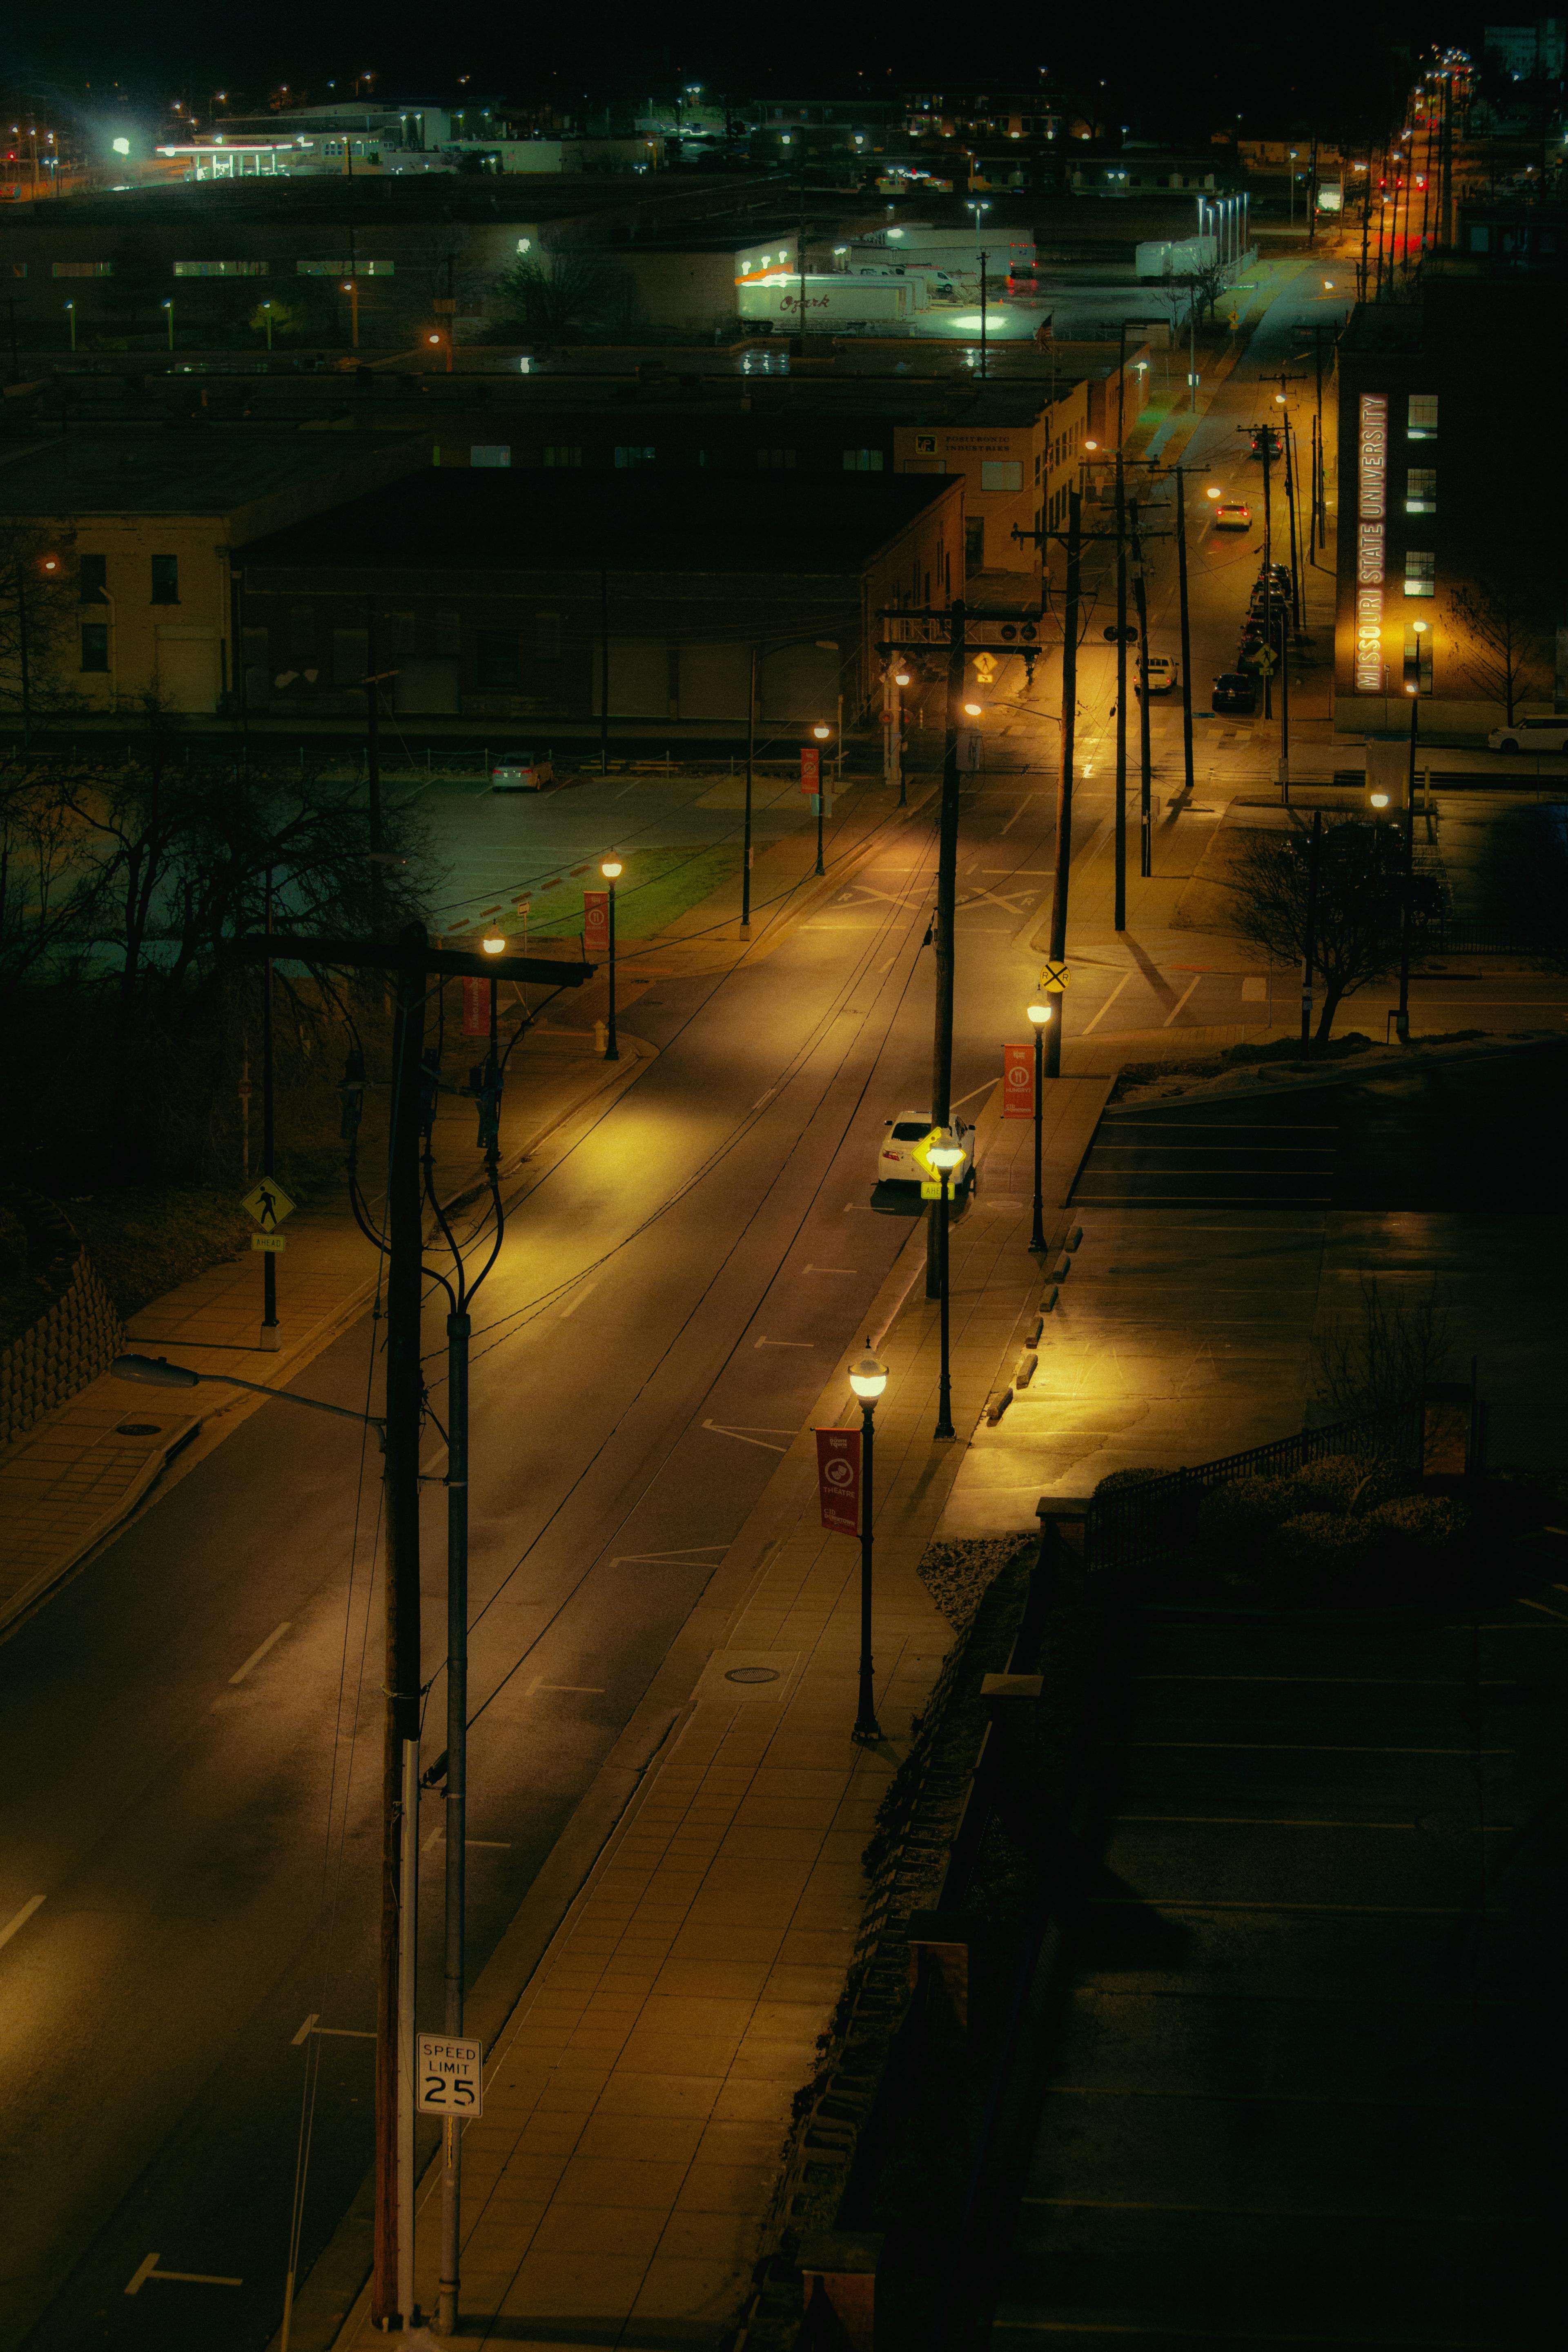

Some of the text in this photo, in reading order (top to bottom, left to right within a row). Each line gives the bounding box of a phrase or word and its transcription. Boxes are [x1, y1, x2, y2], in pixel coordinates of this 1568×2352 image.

[1358, 397, 1384, 689] MISSOURI STATE UNIVERSITY
[1042, 971, 1048, 980] R
[256, 1238, 281, 1247] AHEAD
[823, 1486, 855, 1499] THEATRE
[824, 1514, 855, 1526] DOWNTOWN
[424, 2044, 476, 2060] SPEED
[429, 2060, 470, 2075] LIMIT
[425, 2076, 475, 2106] 25
